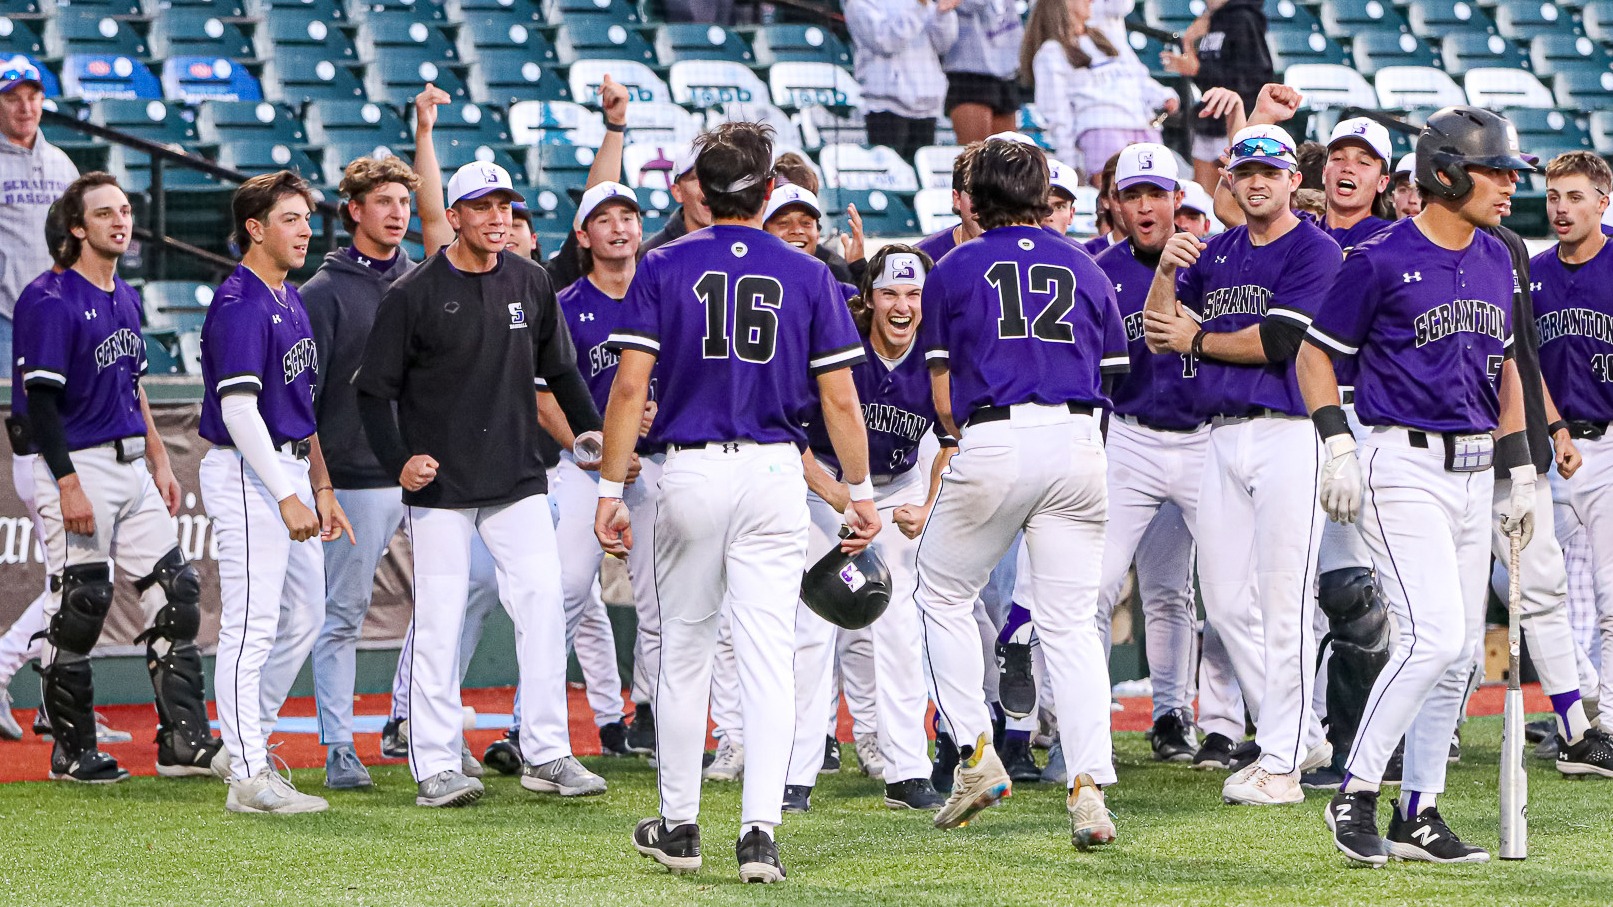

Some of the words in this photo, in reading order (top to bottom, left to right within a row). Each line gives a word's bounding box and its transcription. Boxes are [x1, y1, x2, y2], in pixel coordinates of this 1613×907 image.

[1138, 151, 1154, 171] S
[480, 167, 499, 185] S
[892, 257, 917, 281] S
[508, 302, 525, 324] S
[984, 261, 1076, 344] 12
[692, 270, 784, 364] 16
[1414, 299, 1506, 348] SCRANTON
